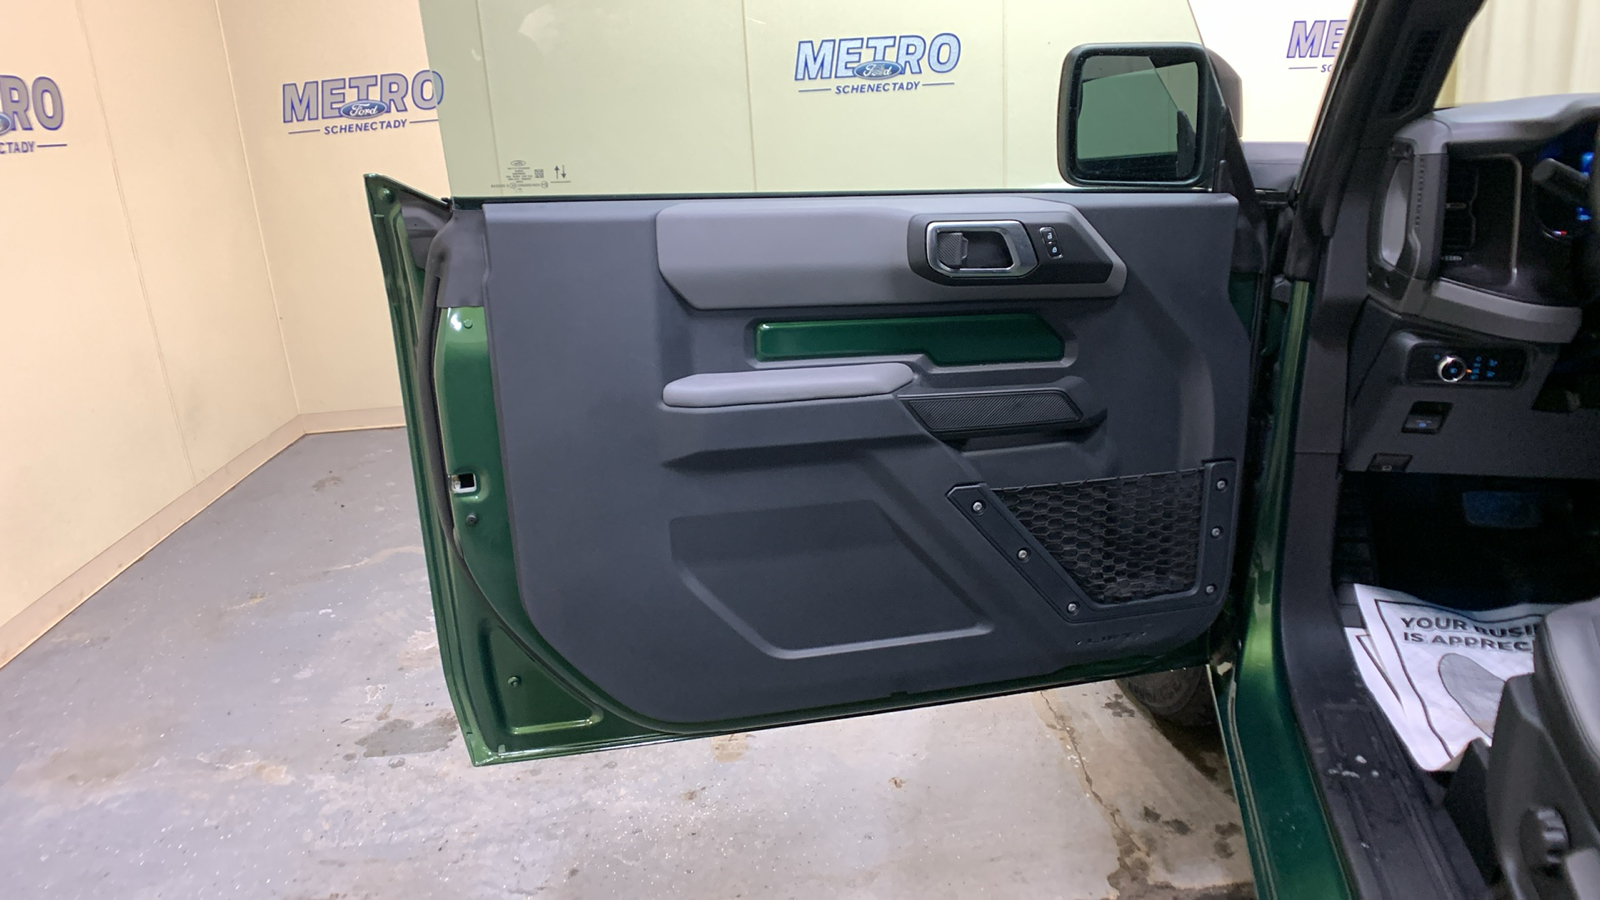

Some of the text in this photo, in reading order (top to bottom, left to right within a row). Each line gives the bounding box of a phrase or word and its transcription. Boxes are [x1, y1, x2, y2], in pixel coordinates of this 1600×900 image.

[1286, 20, 1347, 58] ME
[794, 32, 962, 81] METRO
[282, 69, 445, 123] METRO
[835, 81, 920, 94] SCHENECTADY
[0, 75, 64, 131] RO
[349, 102, 378, 117] Ford
[323, 119, 408, 135] SCHENECTADY
[1400, 617, 1468, 631] YOUR
[1403, 632, 1532, 652] IS APPREC
